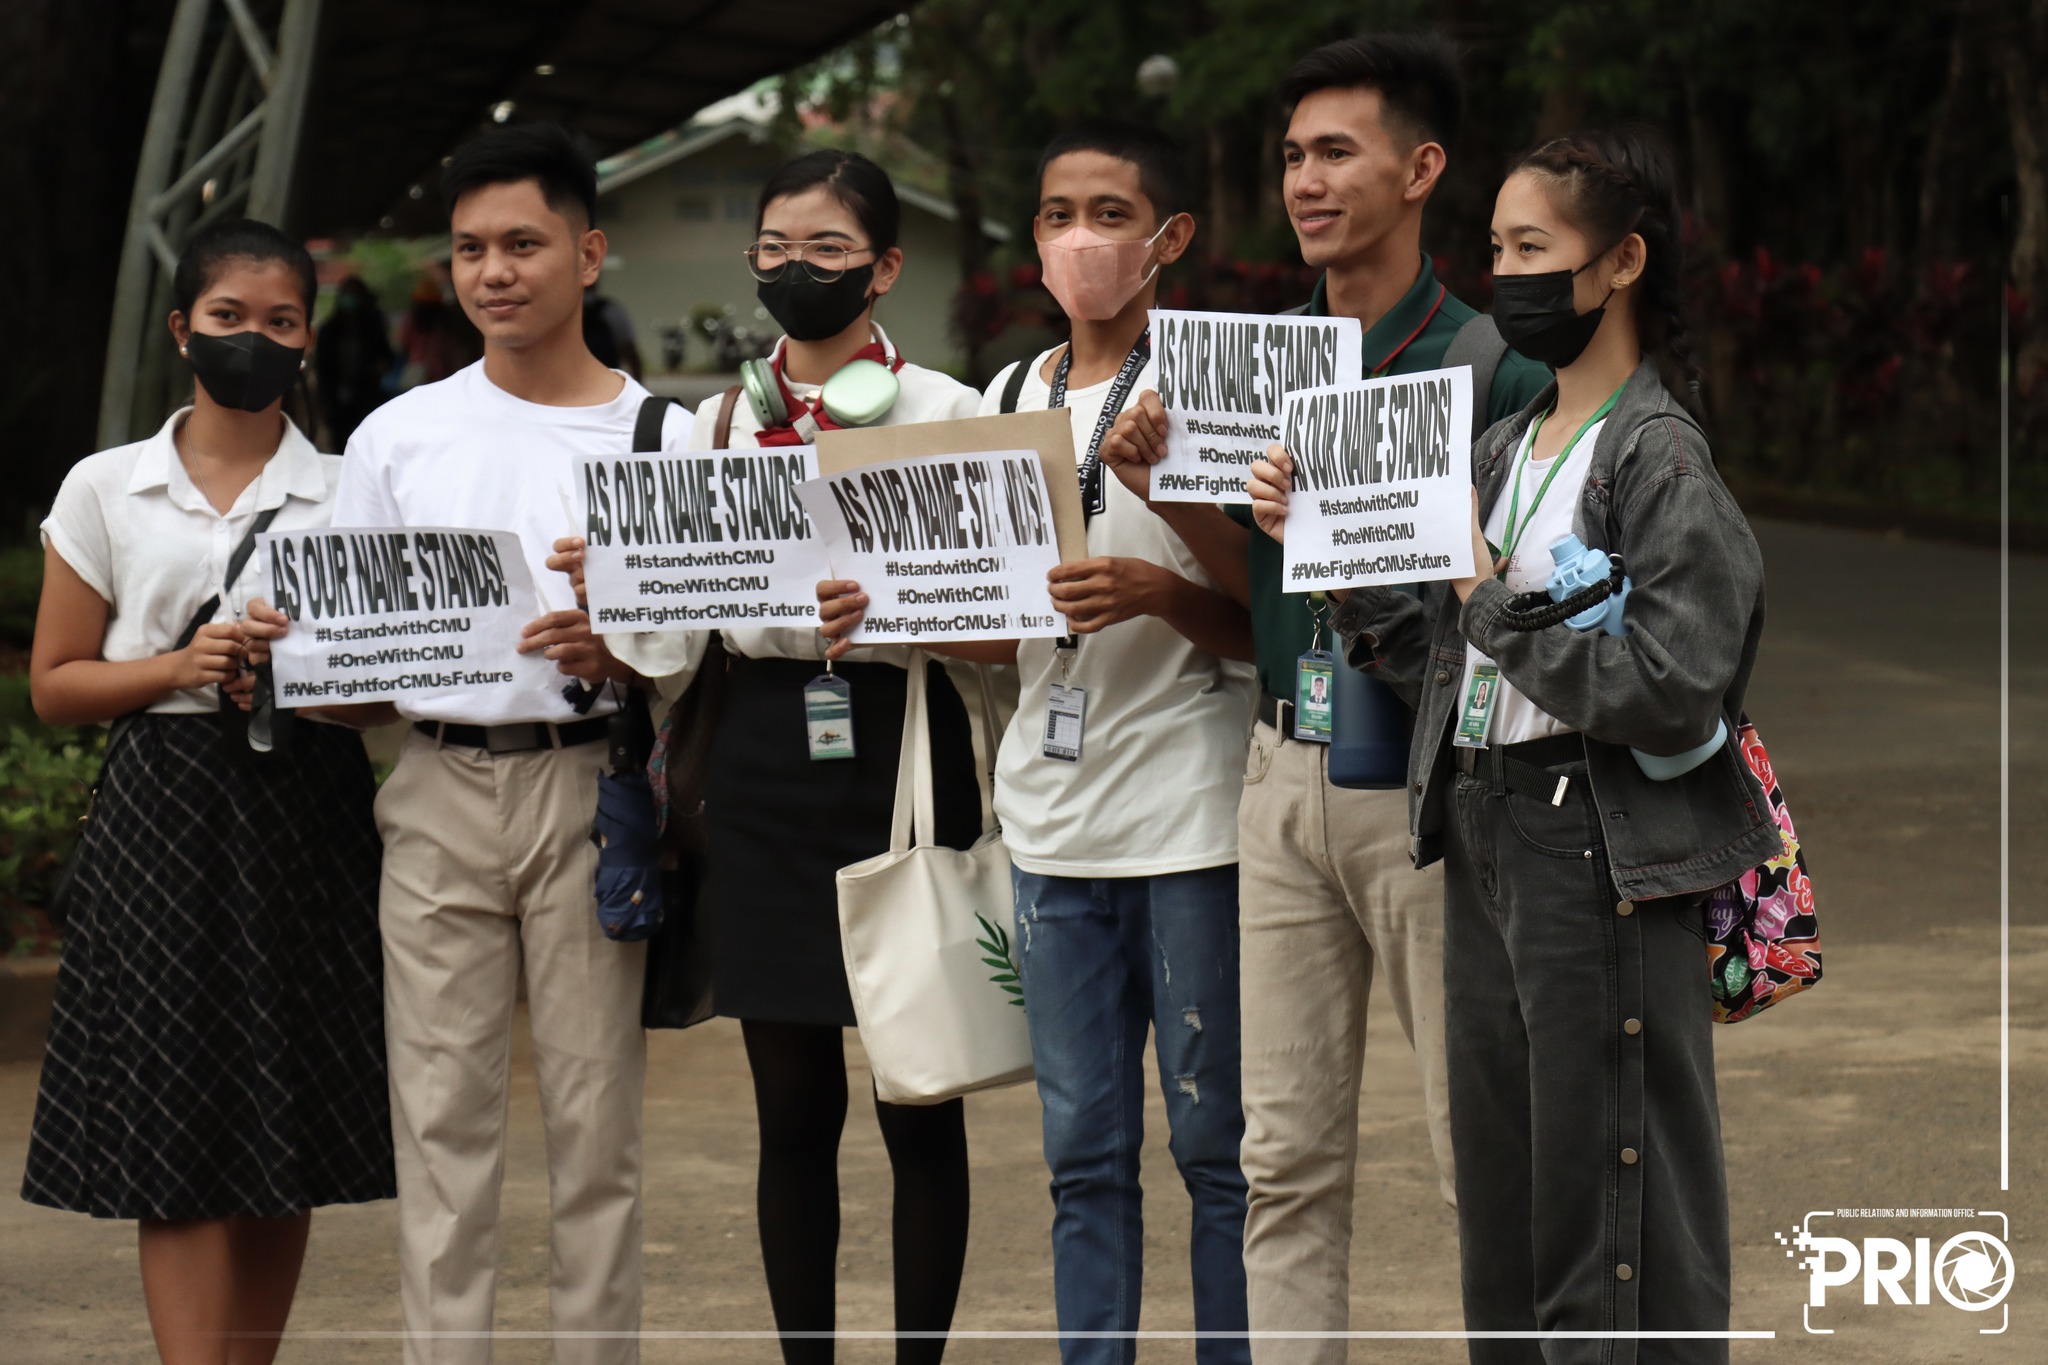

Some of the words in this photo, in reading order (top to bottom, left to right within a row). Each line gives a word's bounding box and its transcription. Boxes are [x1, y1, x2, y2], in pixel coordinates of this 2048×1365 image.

[1158, 318, 1175, 410] AS
[1179, 318, 1213, 411] OUR
[1215, 321, 1262, 414] NAME
[1107, 389, 1128, 421] Human
[1123, 355, 1148, 387] Ecology
[1081, 415, 1107, 479] MINDANAO
[1103, 349, 1140, 412] UNIVERSITY
[1186, 419, 1280, 441] #IstandwithC
[1285, 397, 1309, 492] AS
[1305, 393, 1340, 491] OUR
[1340, 387, 1385, 487] NAME
[1386, 378, 1451, 483] STANDS!
[584, 461, 611, 547] AS
[614, 461, 661, 546] OUR
[659, 458, 723, 544] NAME
[721, 454, 811, 542] STANDS!
[829, 477, 874, 553] AS
[860, 468, 916, 553] OUR
[904, 463, 968, 550] NAME
[1319, 490, 1419, 516] #IstandwithCMU
[1332, 522, 1415, 546] #OneWithCMU
[625, 549, 774, 569] #IstandwithCMU
[1292, 554, 1451, 580] #WeFightforCMUsFuture
[270, 537, 300, 622] AS
[302, 534, 354, 620] OUR
[350, 533, 418, 614] NAME
[414, 532, 509, 611] STANDS!
[638, 576, 769, 595] #OneWithCMU
[598, 602, 816, 625] #WeFightforCMUsFuture
[315, 617, 471, 643] #IstandwithCMU
[327, 645, 463, 669] #OneWithCMU
[283, 669, 513, 697] #WeFightforCMUsFuture
